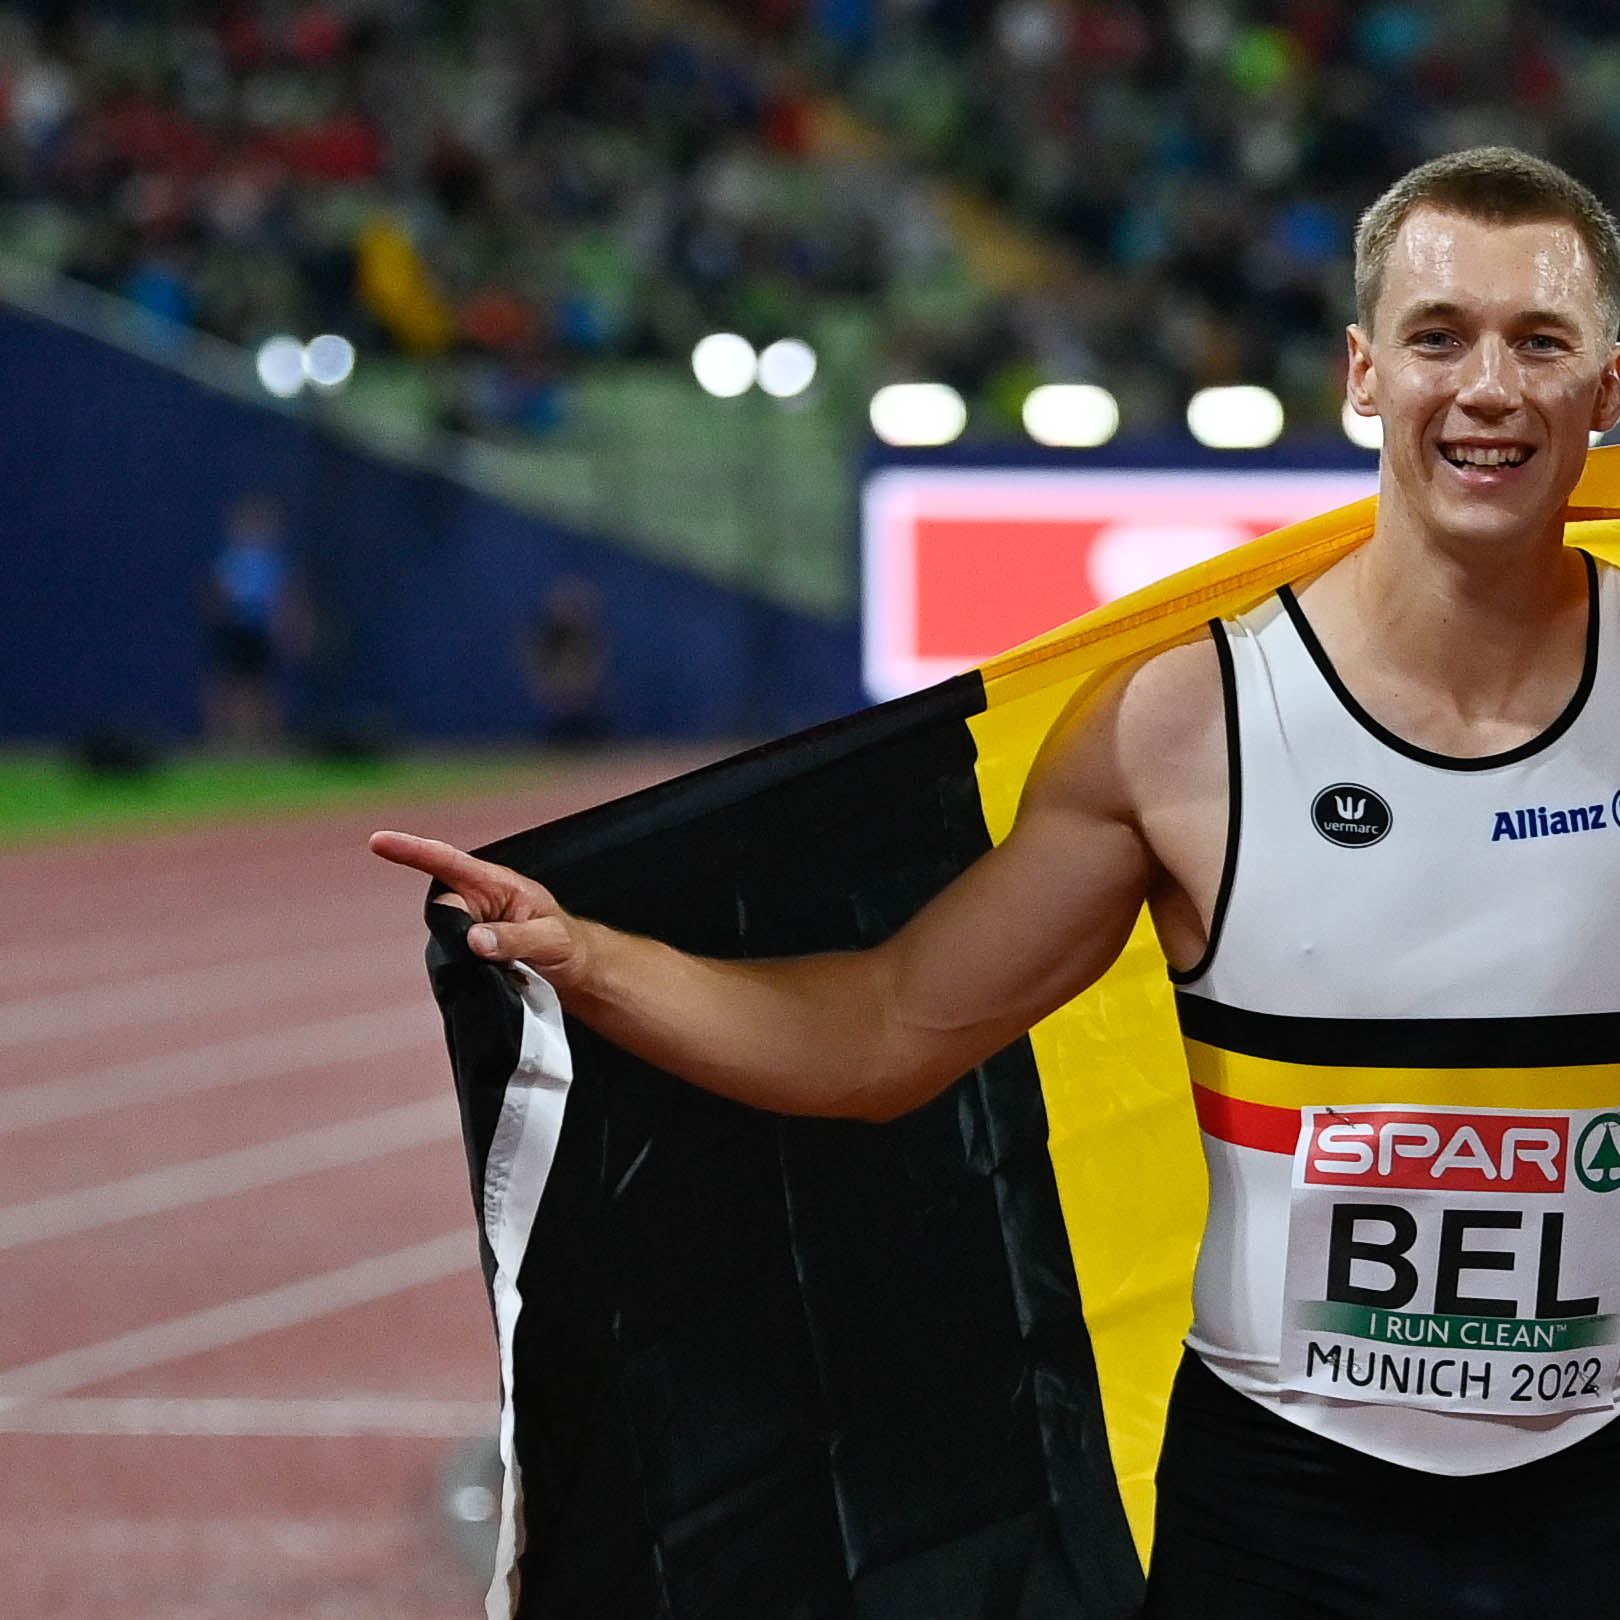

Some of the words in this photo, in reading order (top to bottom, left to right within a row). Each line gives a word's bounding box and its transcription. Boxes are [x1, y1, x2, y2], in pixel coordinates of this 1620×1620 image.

[1323, 819, 1379, 836] vermarc
[1491, 804, 1606, 842] Allianz
[1313, 1123, 1560, 1181] SPAR
[1326, 1203, 1600, 1319] BEL
[1369, 1313, 1377, 1336] I
[1386, 1317, 1451, 1342] RUN
[1306, 1341, 1490, 1400] MUNICH
[1510, 1357, 1602, 1401] 2022
